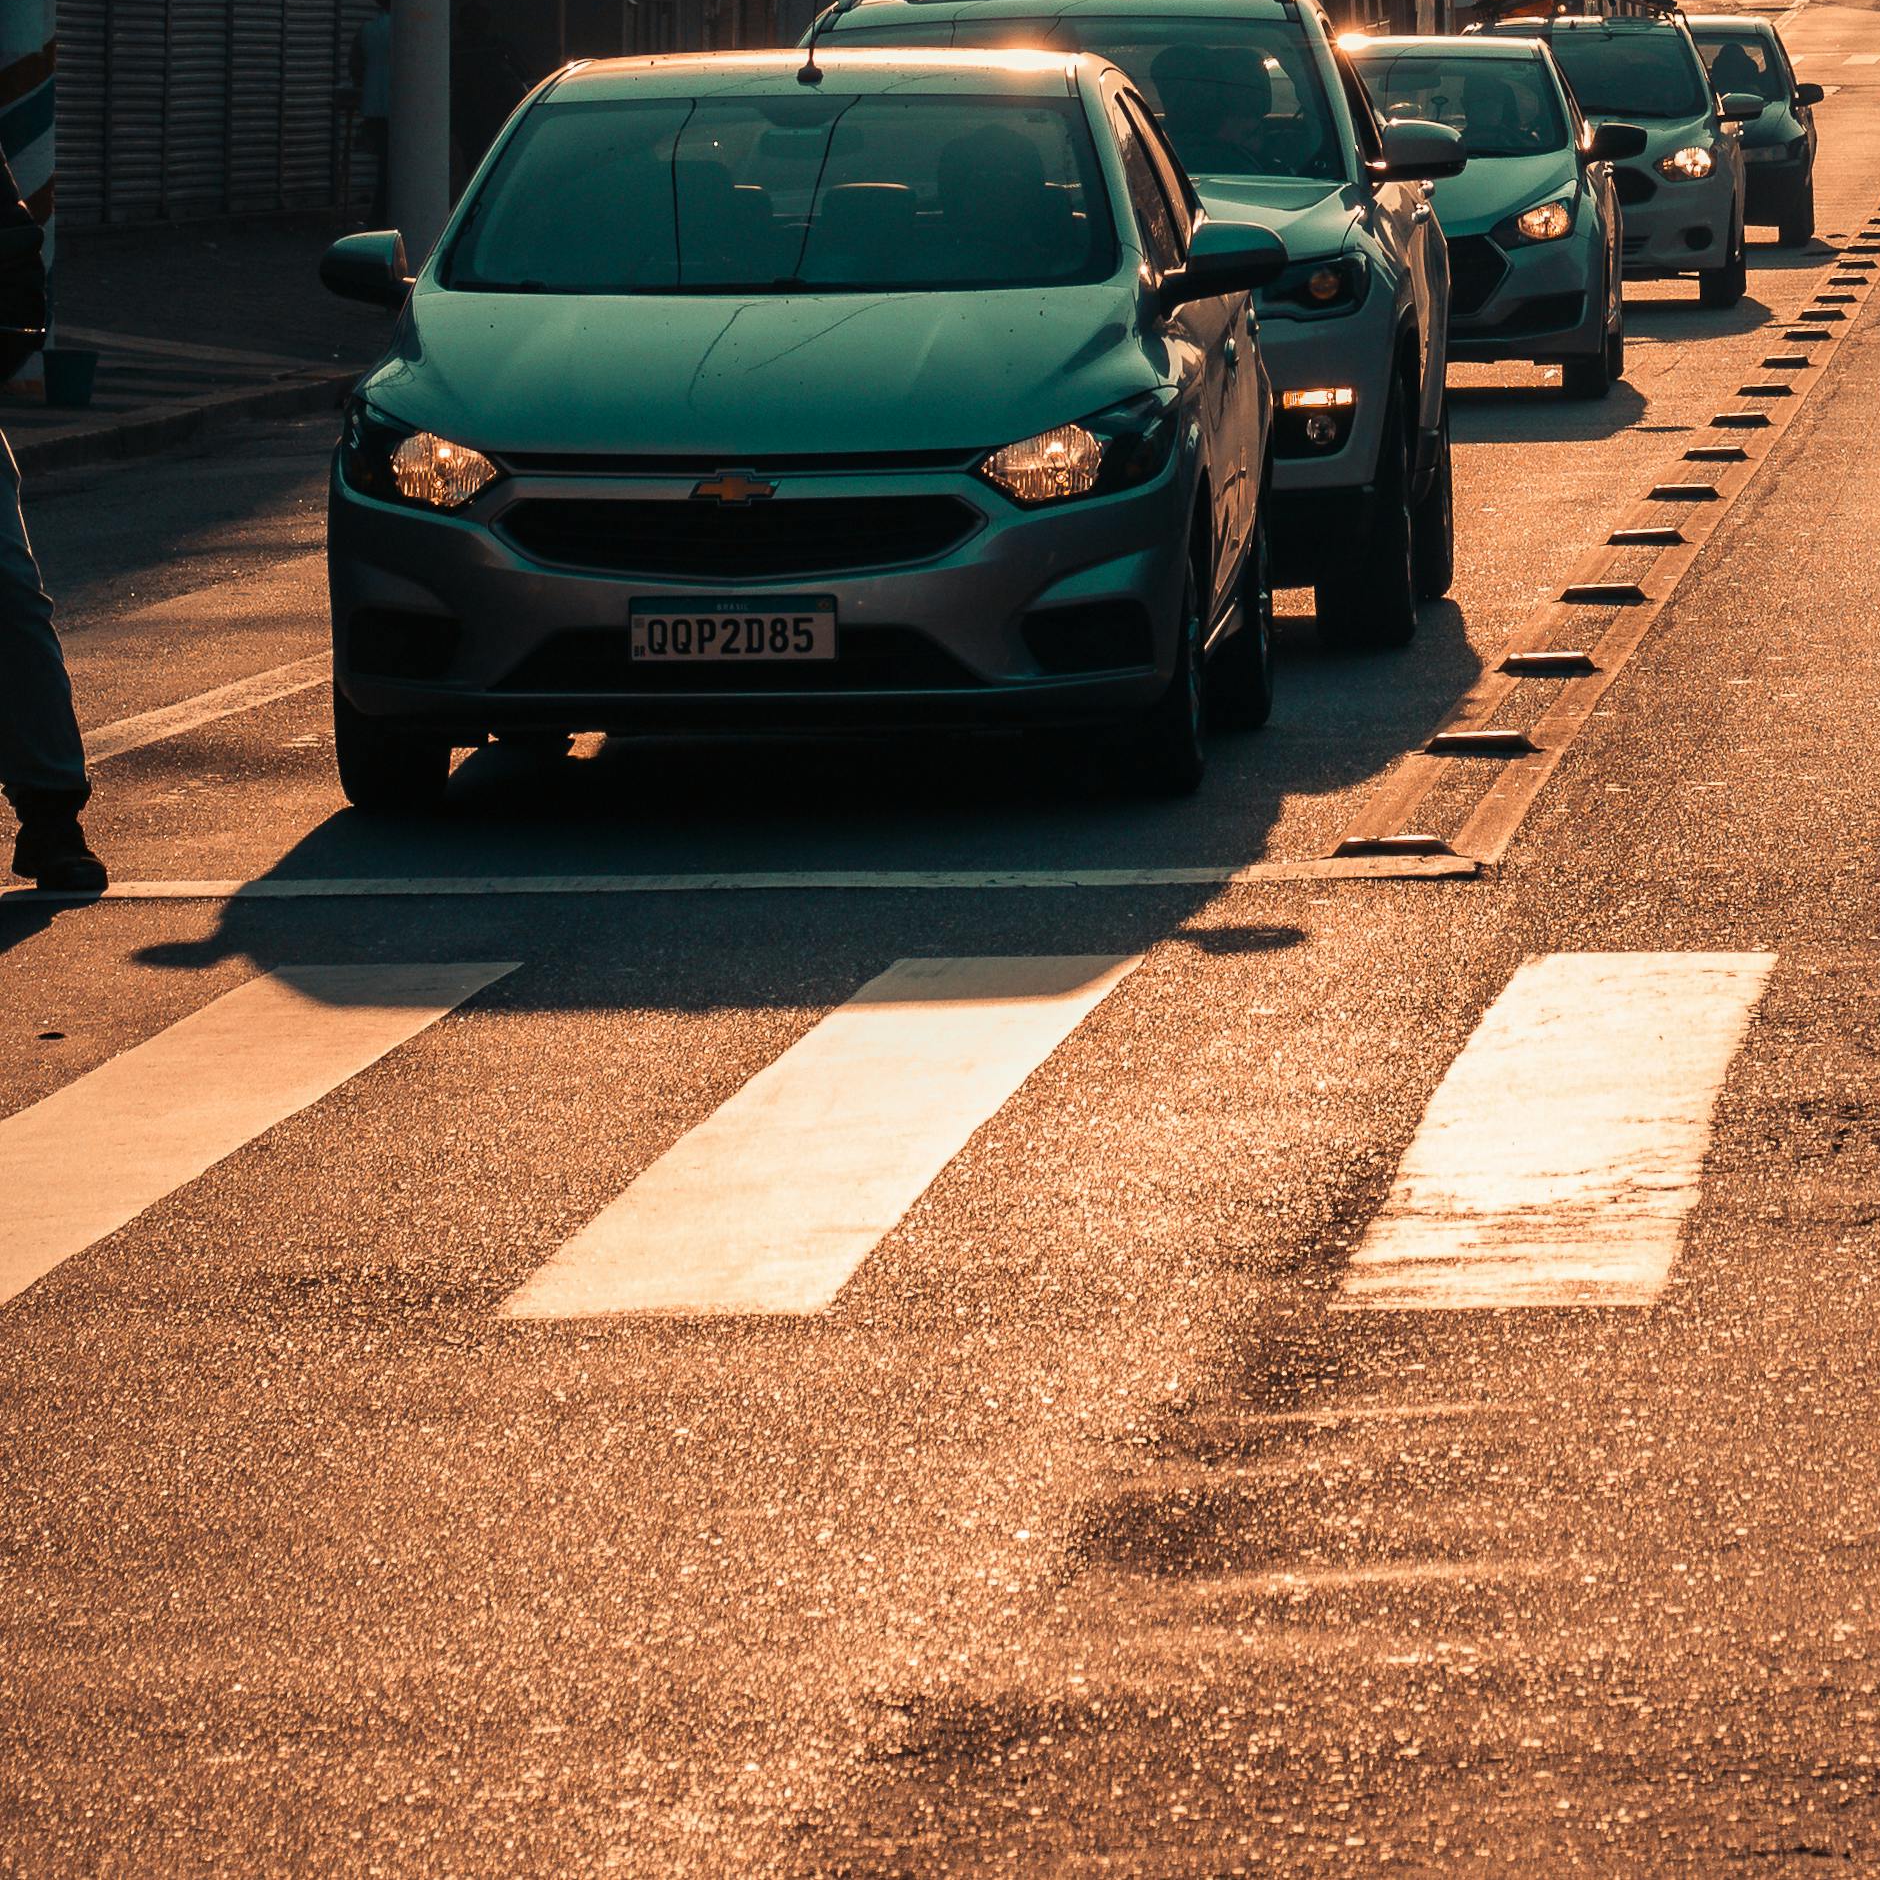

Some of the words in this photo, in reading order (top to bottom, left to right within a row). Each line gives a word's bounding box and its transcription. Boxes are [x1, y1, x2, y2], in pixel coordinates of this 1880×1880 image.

[716, 602, 750, 611] BRASIL
[647, 617, 814, 655] QQP2D85
[634, 645, 646, 657] BR
